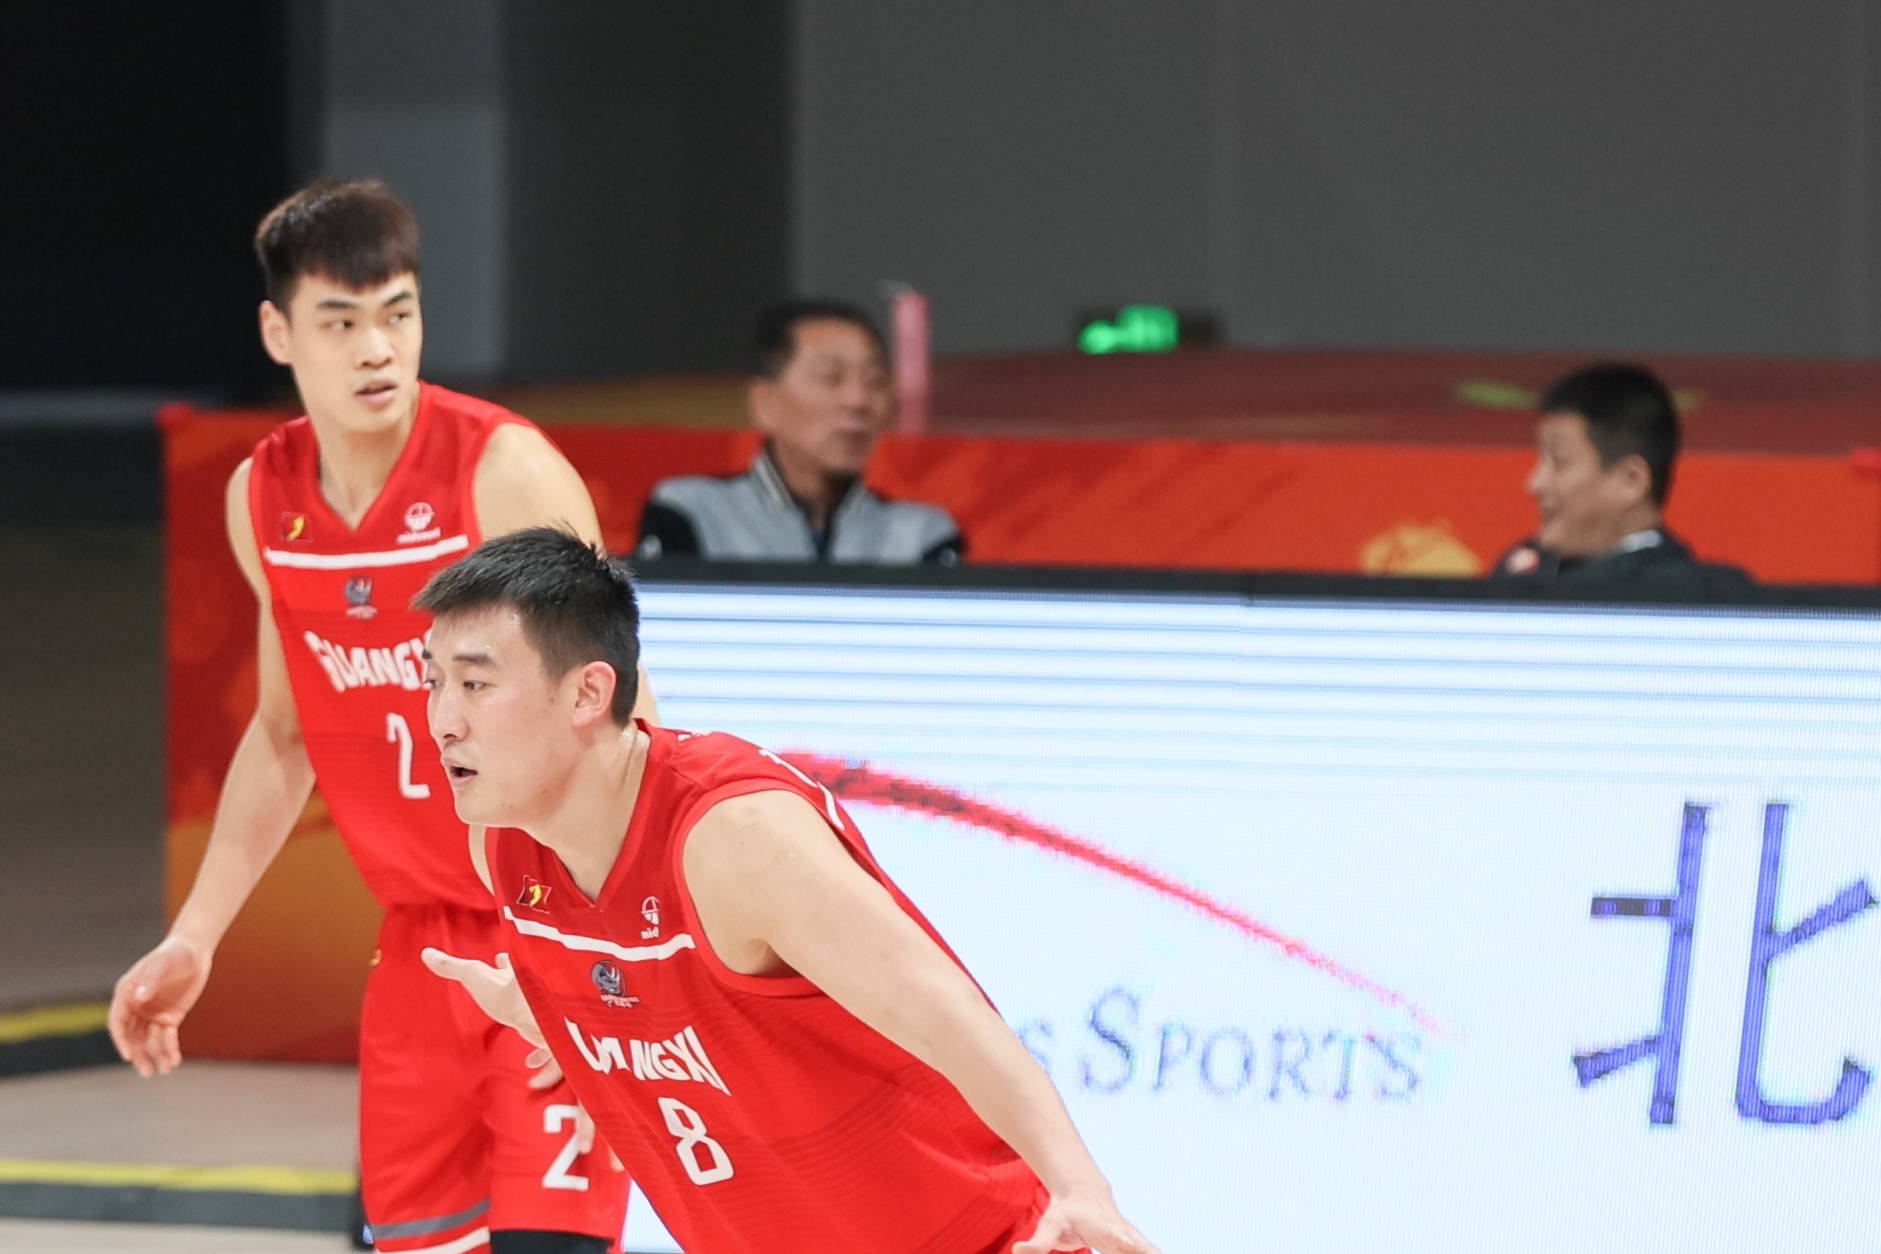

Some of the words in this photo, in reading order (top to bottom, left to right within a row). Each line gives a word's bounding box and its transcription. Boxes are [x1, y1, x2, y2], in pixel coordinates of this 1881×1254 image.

[386, 712, 430, 798] 2
[1573, 800, 1878, 1127] 北
[542, 1104, 590, 1191] 2
[657, 1097, 735, 1186] 8
